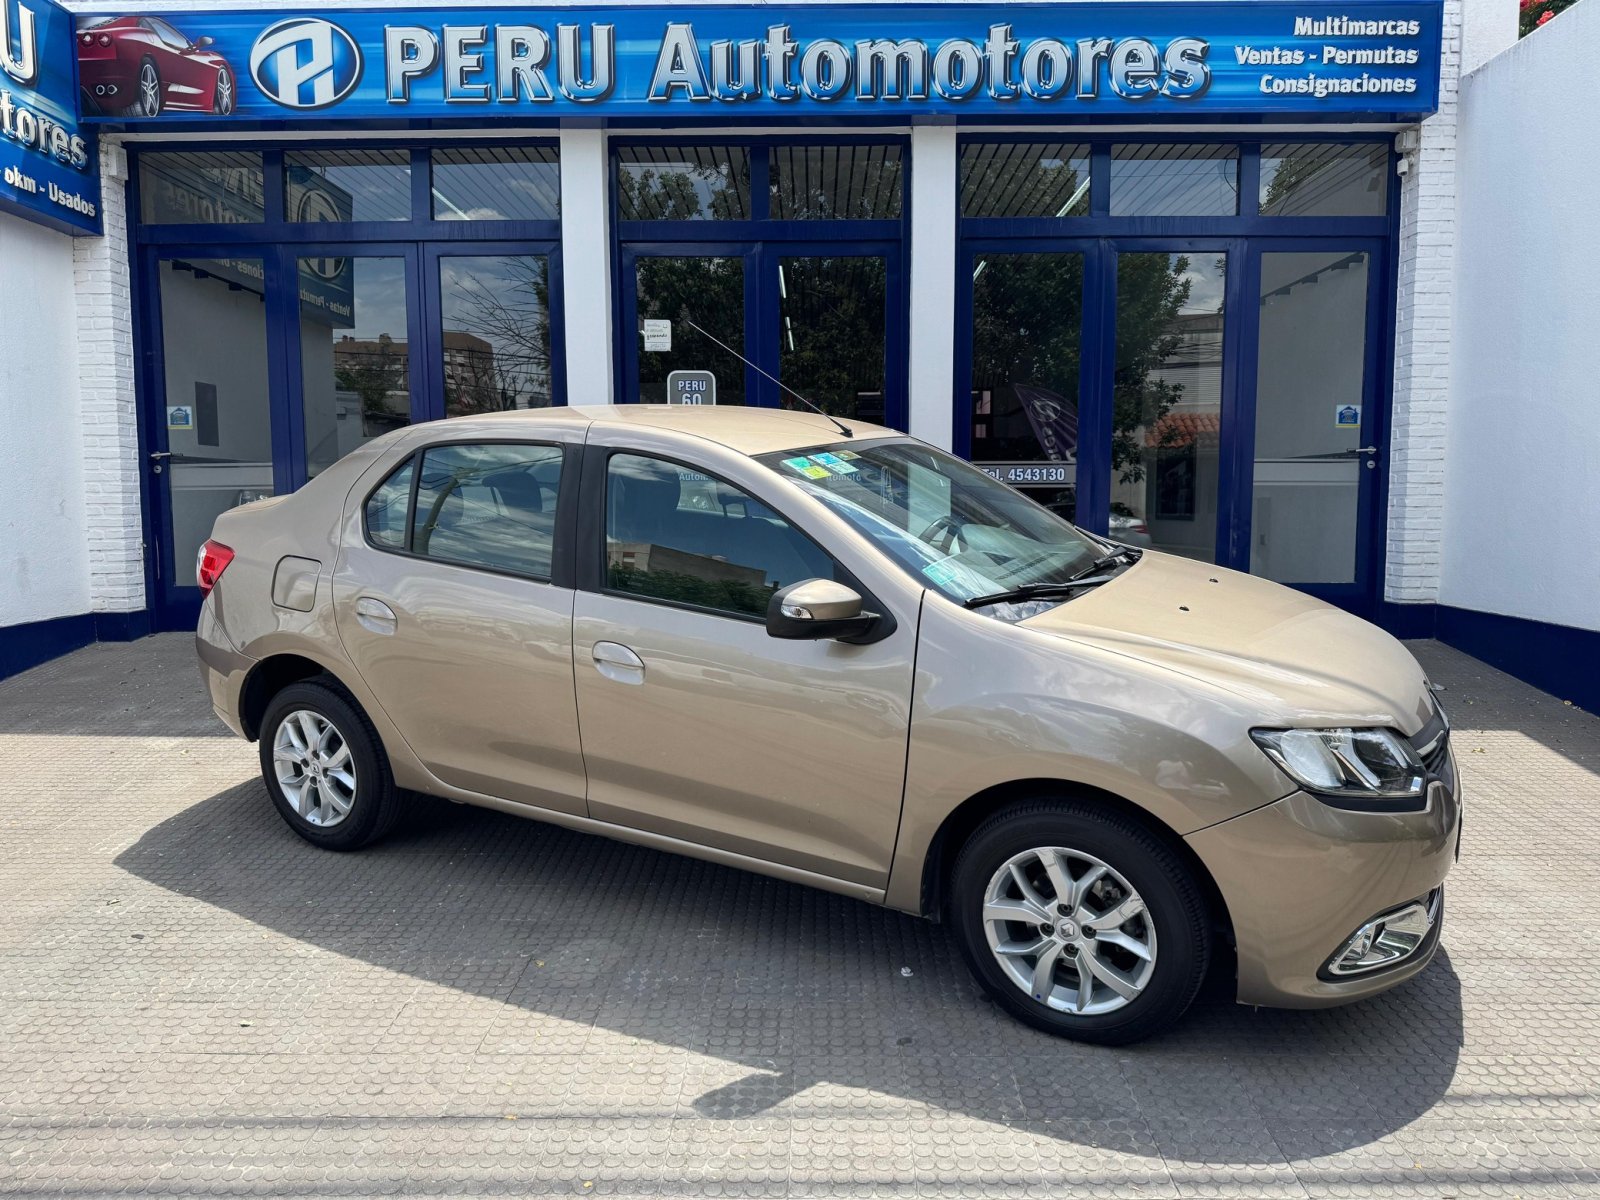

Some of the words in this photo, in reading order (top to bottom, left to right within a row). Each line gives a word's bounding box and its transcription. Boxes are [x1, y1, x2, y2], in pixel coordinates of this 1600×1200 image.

[1293, 15, 1420, 36] Multimarcas
[384, 24, 615, 103] PERU
[648, 21, 1213, 101] Automotores
[1234, 45, 1305, 65] Ventas
[1322, 45, 1419, 65] Permutas
[1260, 72, 1417, 98] Consignaciones
[48, 180, 96, 217] Usados
[678, 380, 706, 391] PERU
[1008, 468, 1065, 481] 4543130
